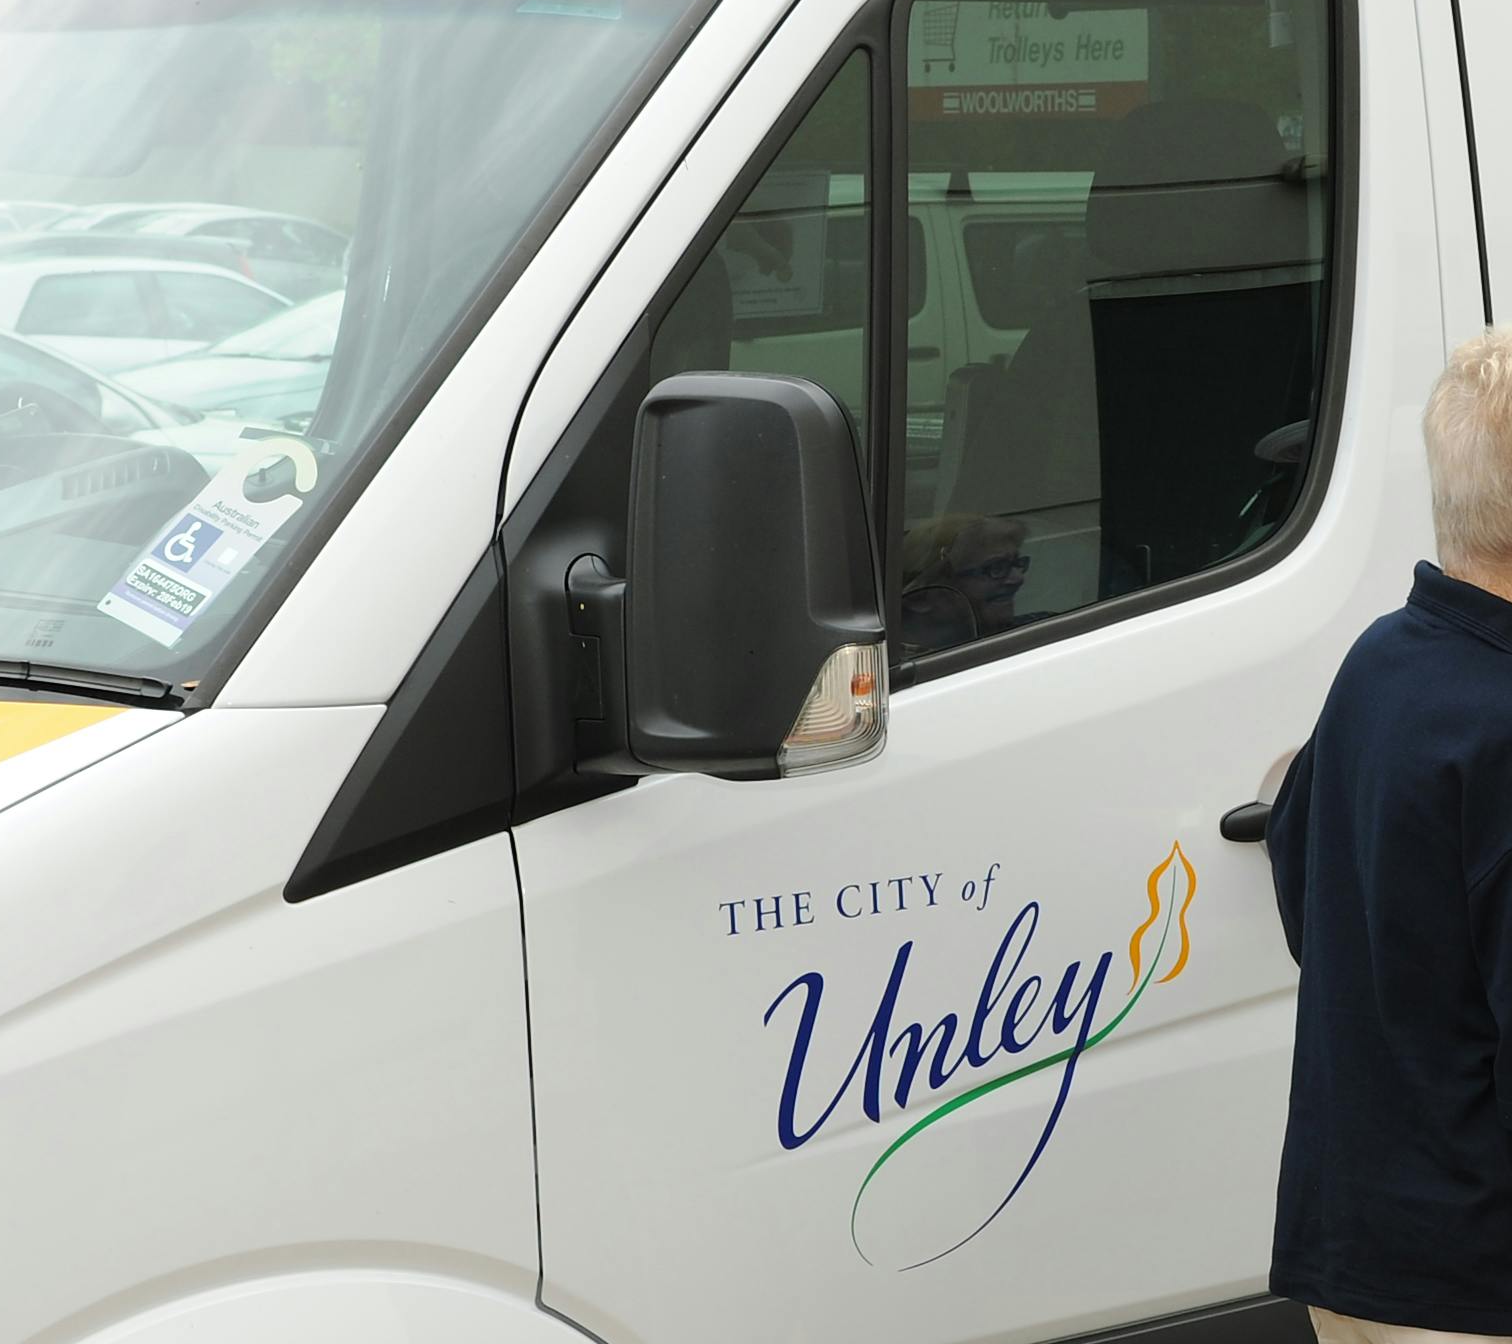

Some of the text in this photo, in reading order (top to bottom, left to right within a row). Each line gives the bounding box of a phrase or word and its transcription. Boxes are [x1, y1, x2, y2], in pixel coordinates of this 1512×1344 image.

[988, 33, 1125, 68] Trolleys Here
[960, 89, 1078, 114] WOOLWORTHS
[211, 500, 260, 529] Australian
[718, 862, 1001, 937] THE CITY of
[763, 900, 1114, 1273] Unley
